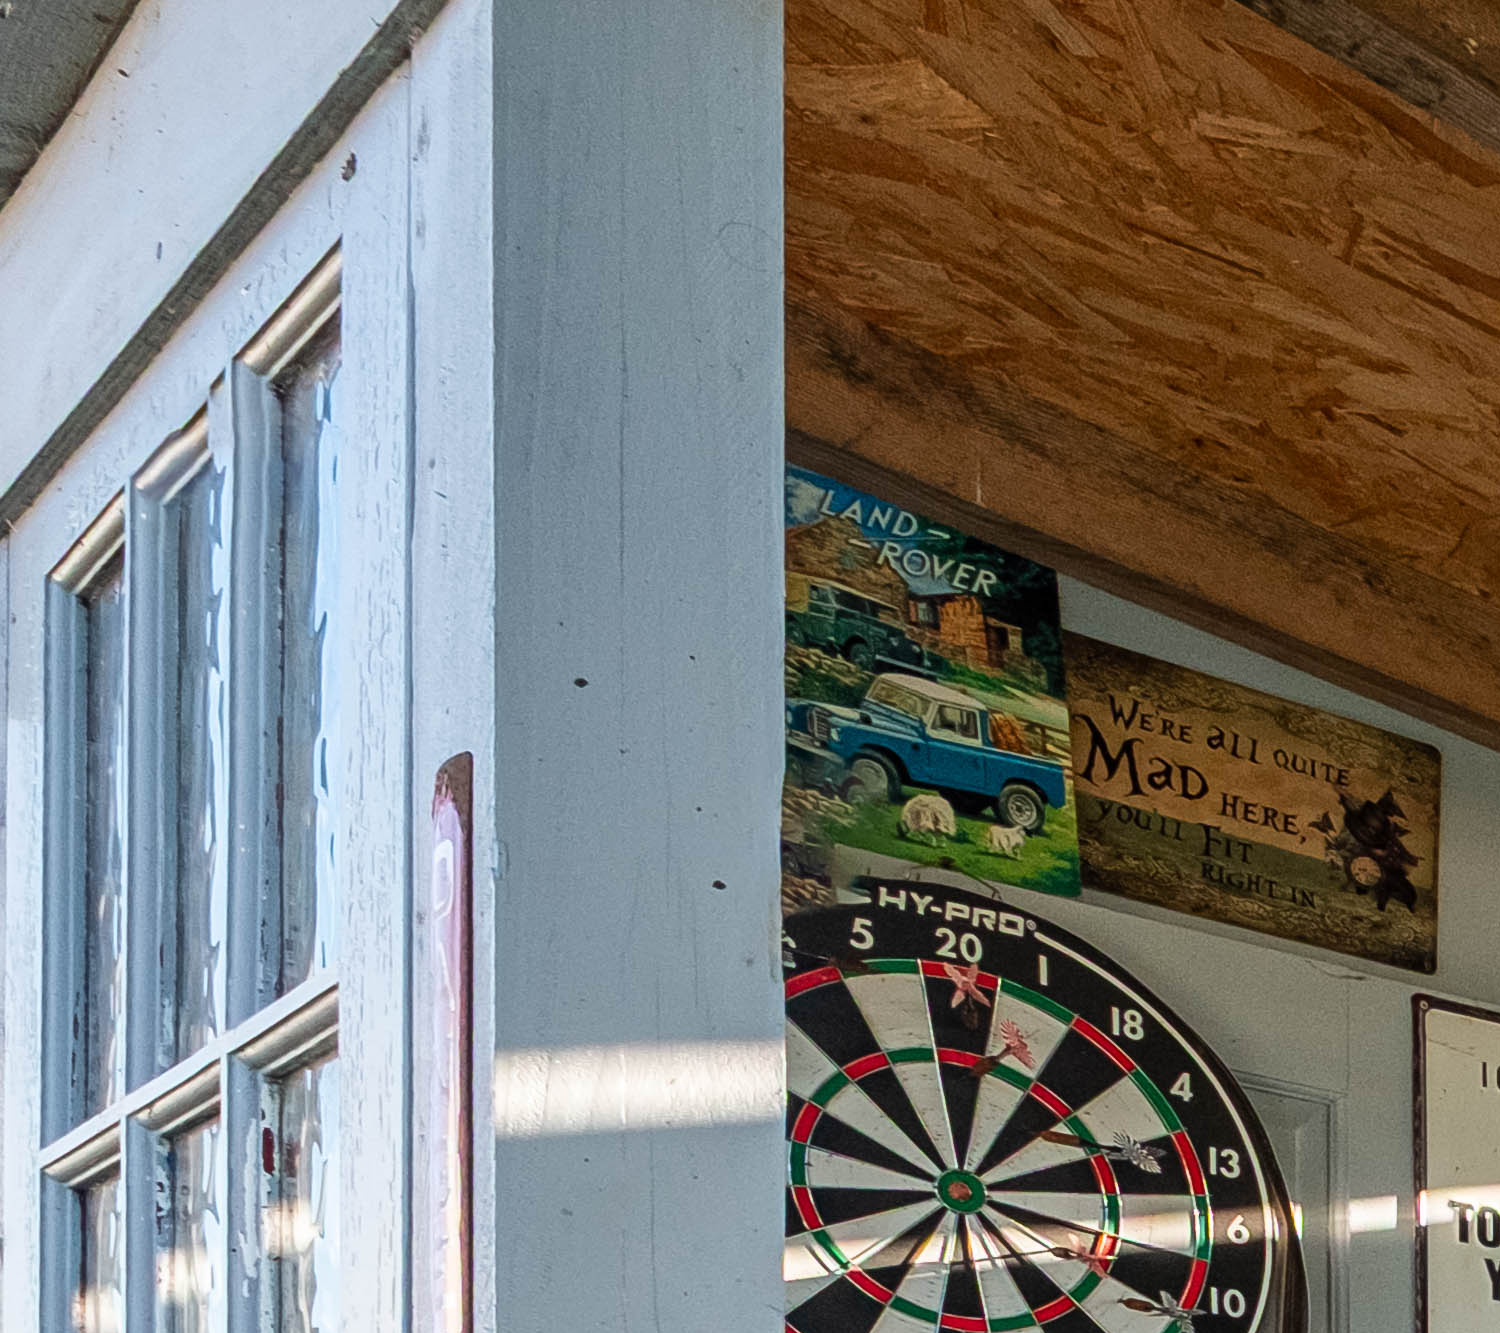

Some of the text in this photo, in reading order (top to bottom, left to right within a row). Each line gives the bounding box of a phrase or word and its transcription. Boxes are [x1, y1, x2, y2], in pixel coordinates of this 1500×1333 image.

[820, 489, 918, 537] LAND
[877, 541, 997, 597] ROVER
[1273, 749, 1350, 787] QUITE
[879, 887, 1025, 936] HY-PRO
[850, 918, 874, 950] 5
[936, 928, 982, 962] 20
[1039, 955, 1048, 985] 1
[1111, 1006, 1144, 1040] 18
[1170, 1072, 1193, 1102] 4
[1482, 1062, 1487, 1087] I
[1209, 1147, 1240, 1178] 13
[1227, 1214, 1249, 1244] 6
[1210, 1287, 1245, 1318] 10
